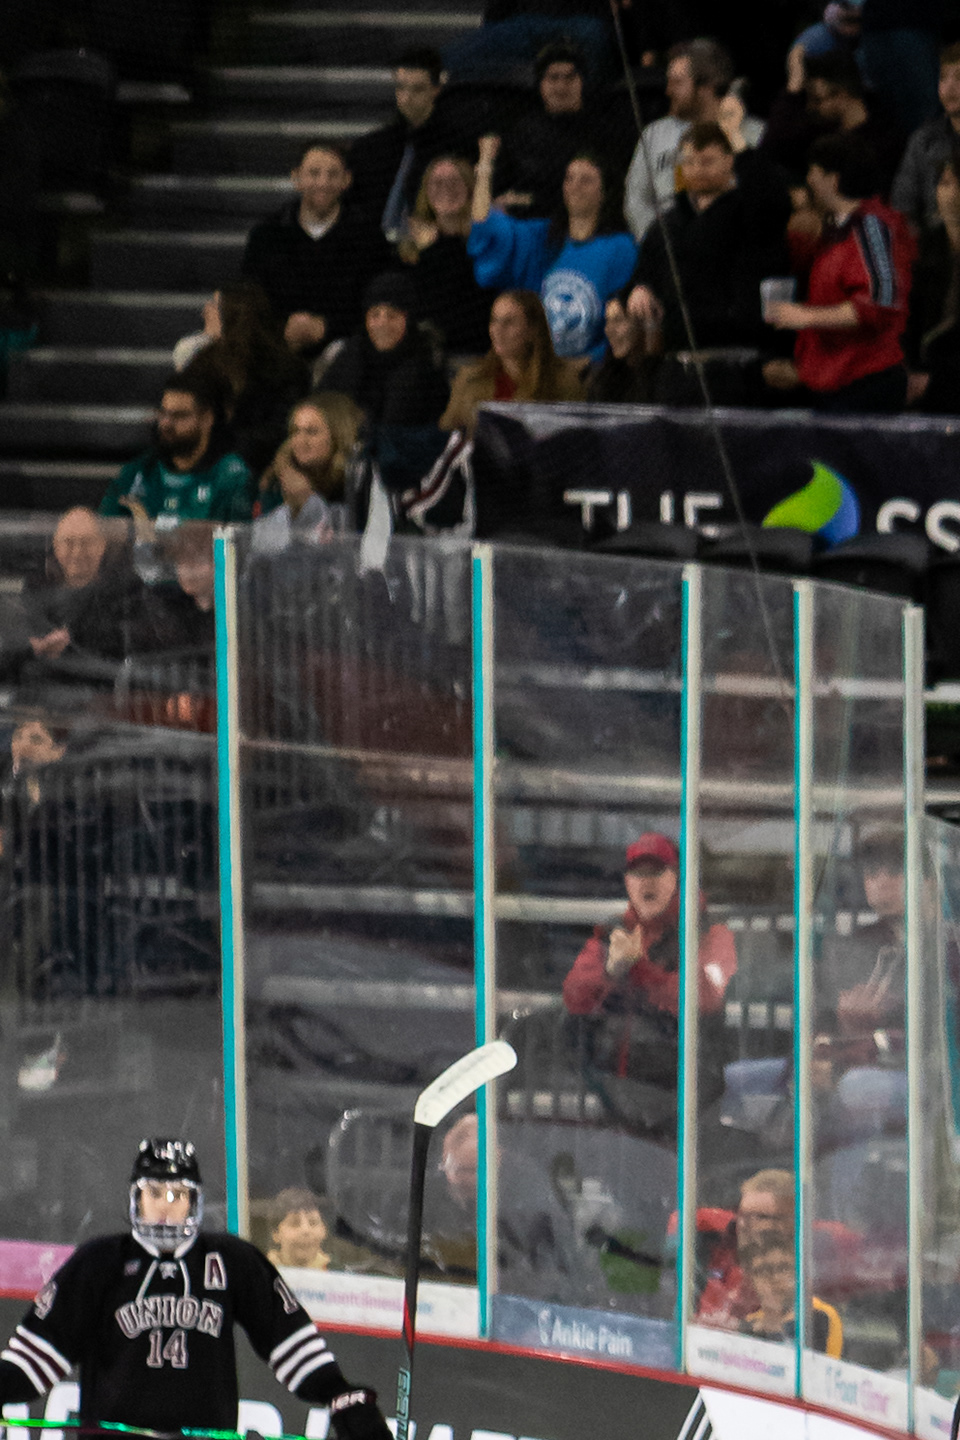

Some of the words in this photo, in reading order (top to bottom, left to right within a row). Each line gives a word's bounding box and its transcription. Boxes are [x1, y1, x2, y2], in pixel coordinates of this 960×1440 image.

[204, 1252, 228, 1290] A
[114, 1293, 224, 1340] UNION
[146, 1329, 190, 1370] 14
